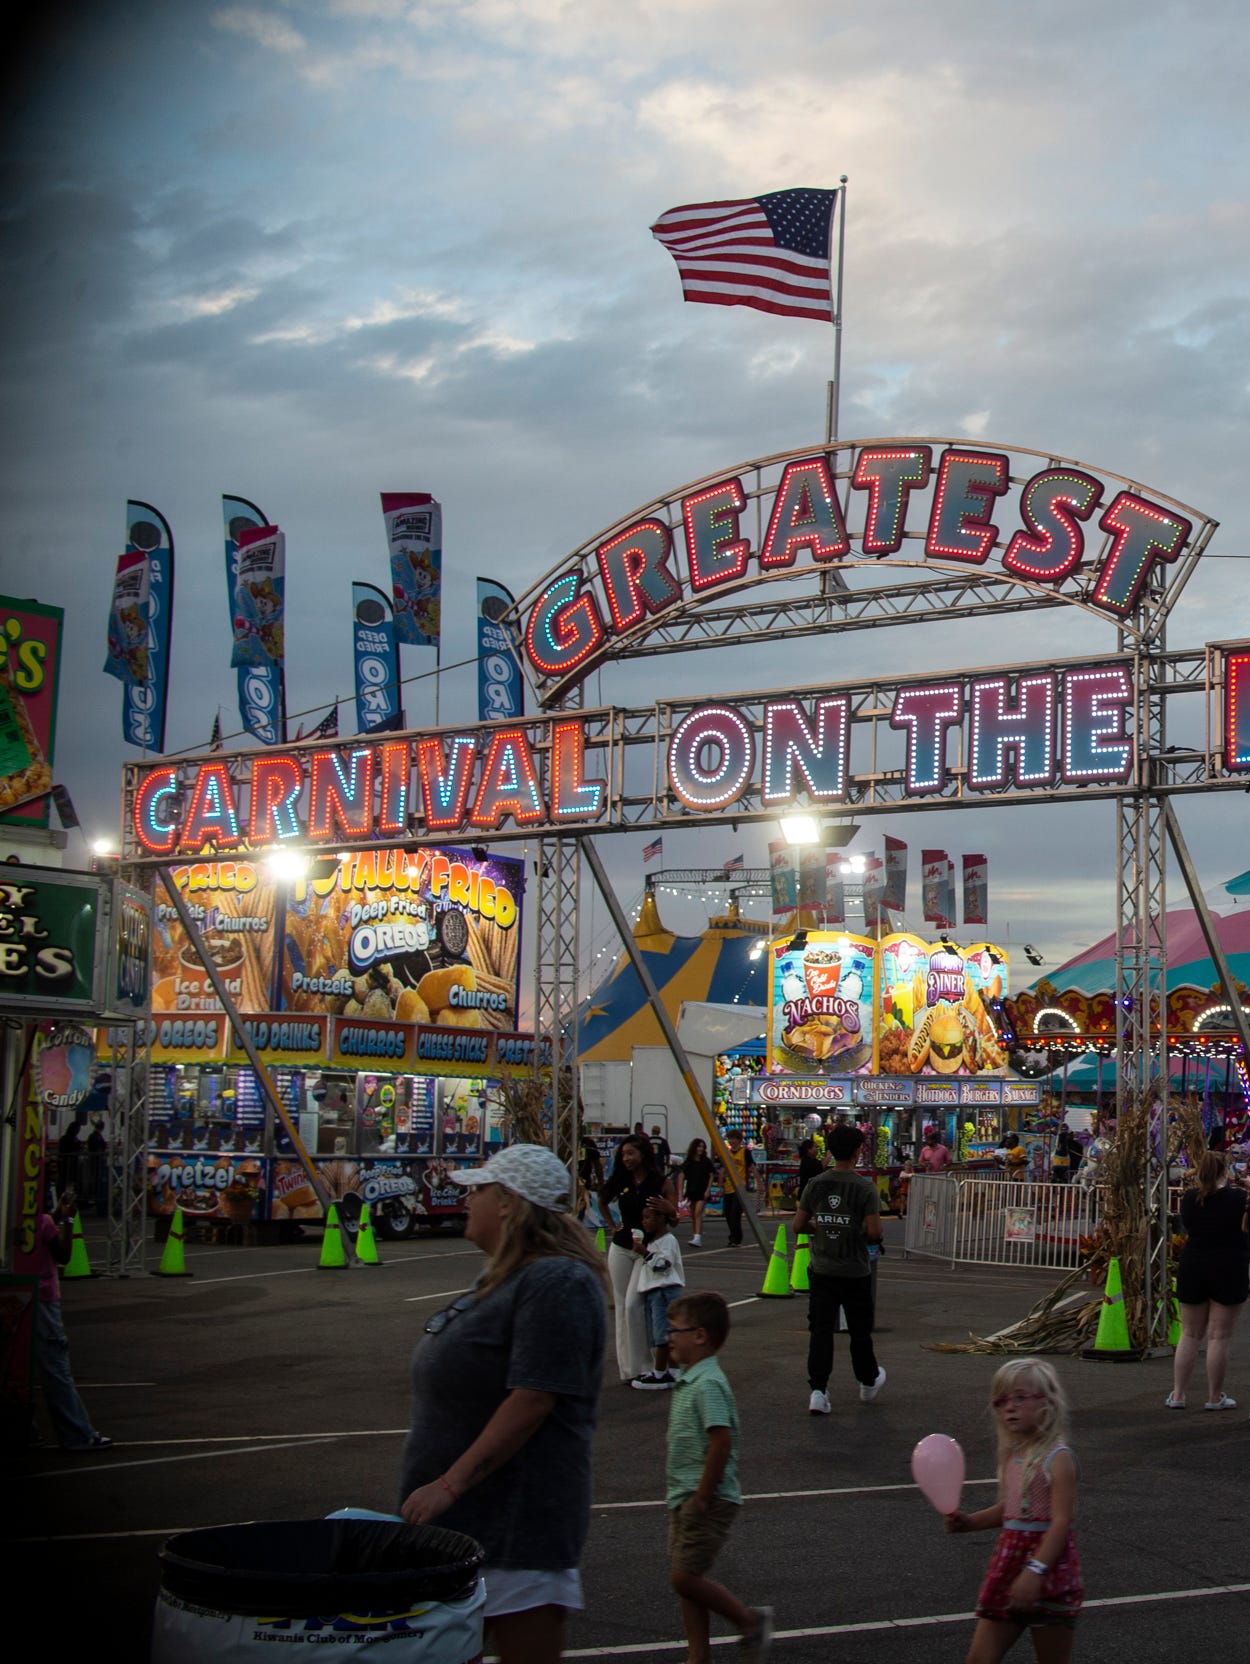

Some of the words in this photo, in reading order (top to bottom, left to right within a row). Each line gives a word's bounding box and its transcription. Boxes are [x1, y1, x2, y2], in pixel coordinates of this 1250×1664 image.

[525, 445, 1193, 677] GREATEST
[668, 696, 850, 812] ON
[890, 665, 1133, 797] THE
[134, 720, 606, 852] CARNIVAL
[173, 861, 257, 892] FRIED
[432, 856, 516, 928] FRIED
[157, 903, 206, 922] Preels
[351, 897, 388, 927] Deep
[390, 894, 428, 920] Fried
[215, 914, 268, 932] Churros
[352, 923, 429, 960] OREOS
[174, 977, 199, 994] Ice
[203, 977, 242, 994] Cld
[292, 971, 353, 996] Pretzels
[927, 971, 965, 1004] DINER
[448, 984, 507, 1011] Churros
[784, 996, 859, 1033] NACHOS
[47, 1029, 92, 1048] Cotton
[159, 1019, 218, 1049] OREOS
[339, 1027, 405, 1058] CHURROS
[418, 1032, 454, 1061] CHEESE
[454, 1035, 488, 1063] STICKS
[759, 1081, 844, 1101] CORNDOGS
[860, 1079, 897, 1091] CHICKEN
[869, 1091, 910, 1101] TENDERS
[917, 1084, 959, 1103] HOTDOGS
[960, 1083, 999, 1104] BURGERS
[1002, 1083, 1038, 1104] SAUSAGE
[44, 1088, 86, 1108] Candy
[364, 1178, 416, 1200] OREOS
[816, 1215, 851, 1225] ARIAT
[252, 1631, 304, 1644] Kiwanis
[306, 1633, 337, 1645] Club
[338, 1633, 351, 1645] of
